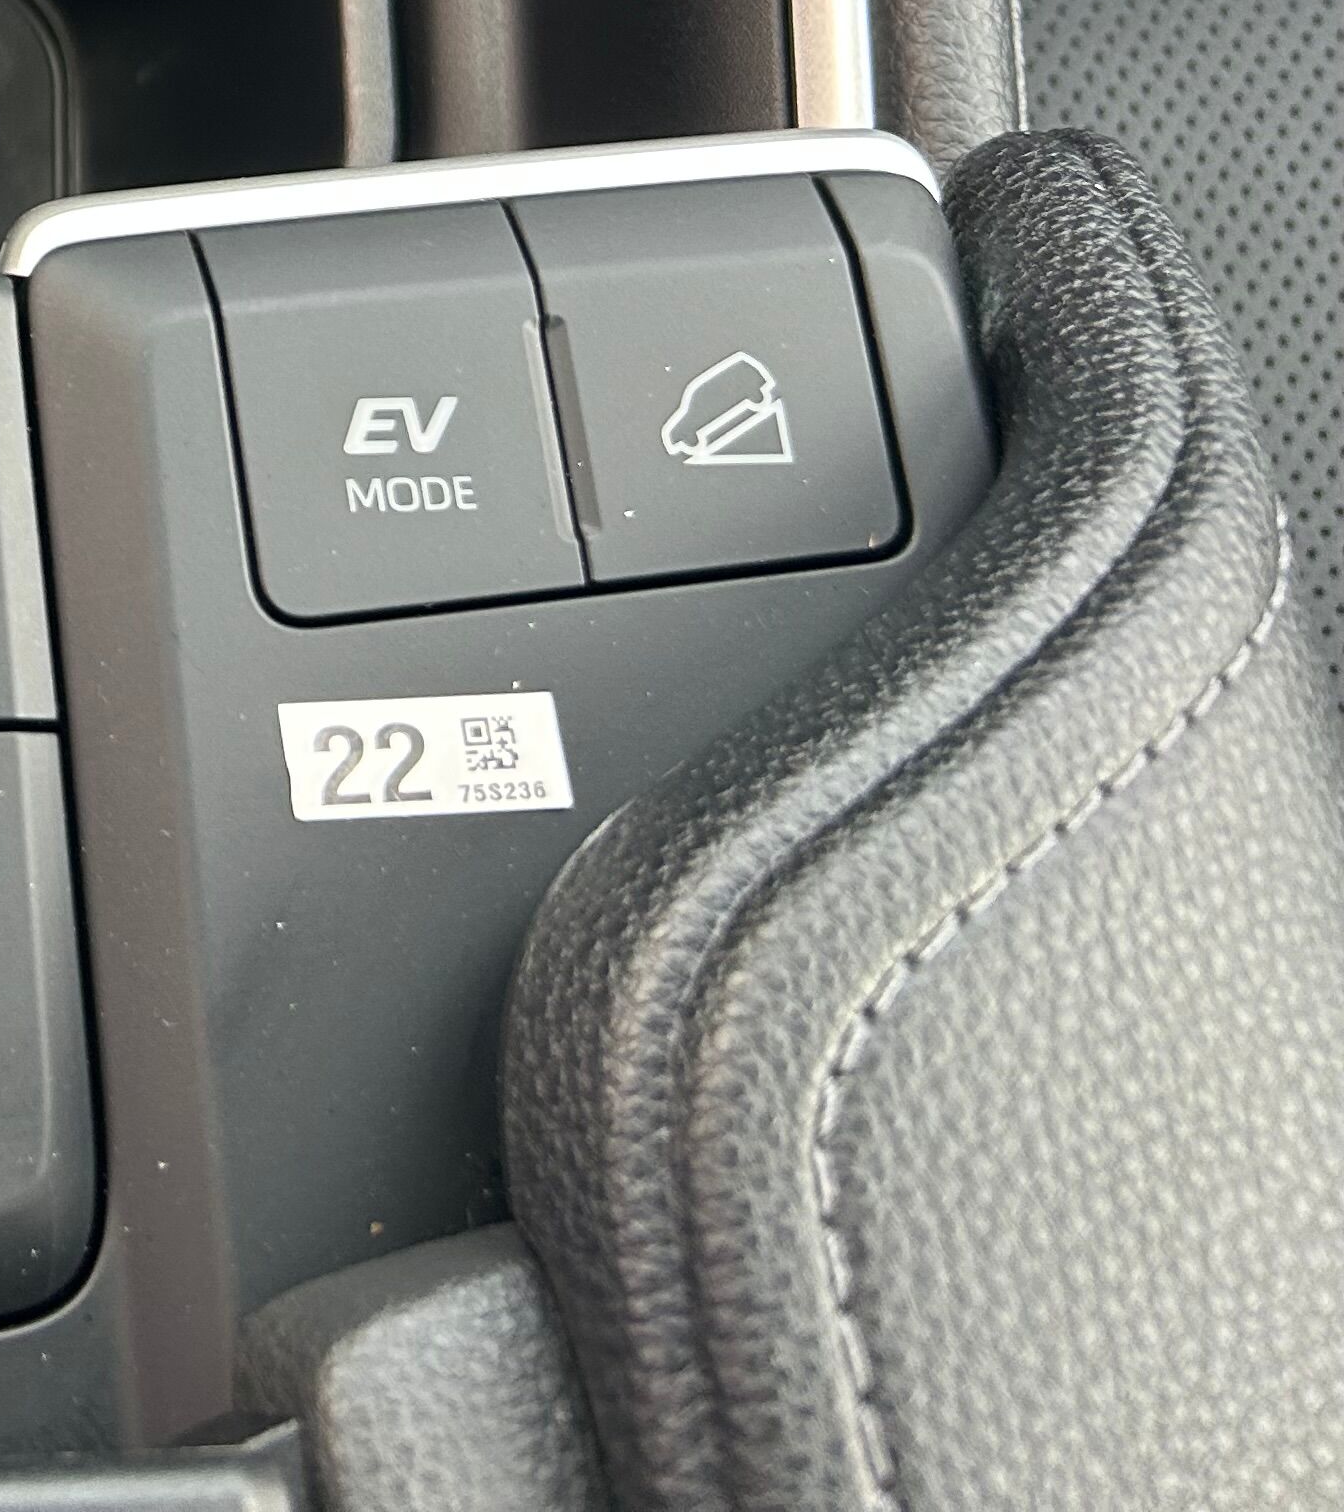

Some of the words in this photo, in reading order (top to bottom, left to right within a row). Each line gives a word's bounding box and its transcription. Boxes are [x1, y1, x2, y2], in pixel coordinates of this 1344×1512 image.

[343, 396, 459, 456] EV
[345, 476, 479, 514] MODE
[313, 721, 434, 807] 22
[457, 780, 548, 805] 75S236
